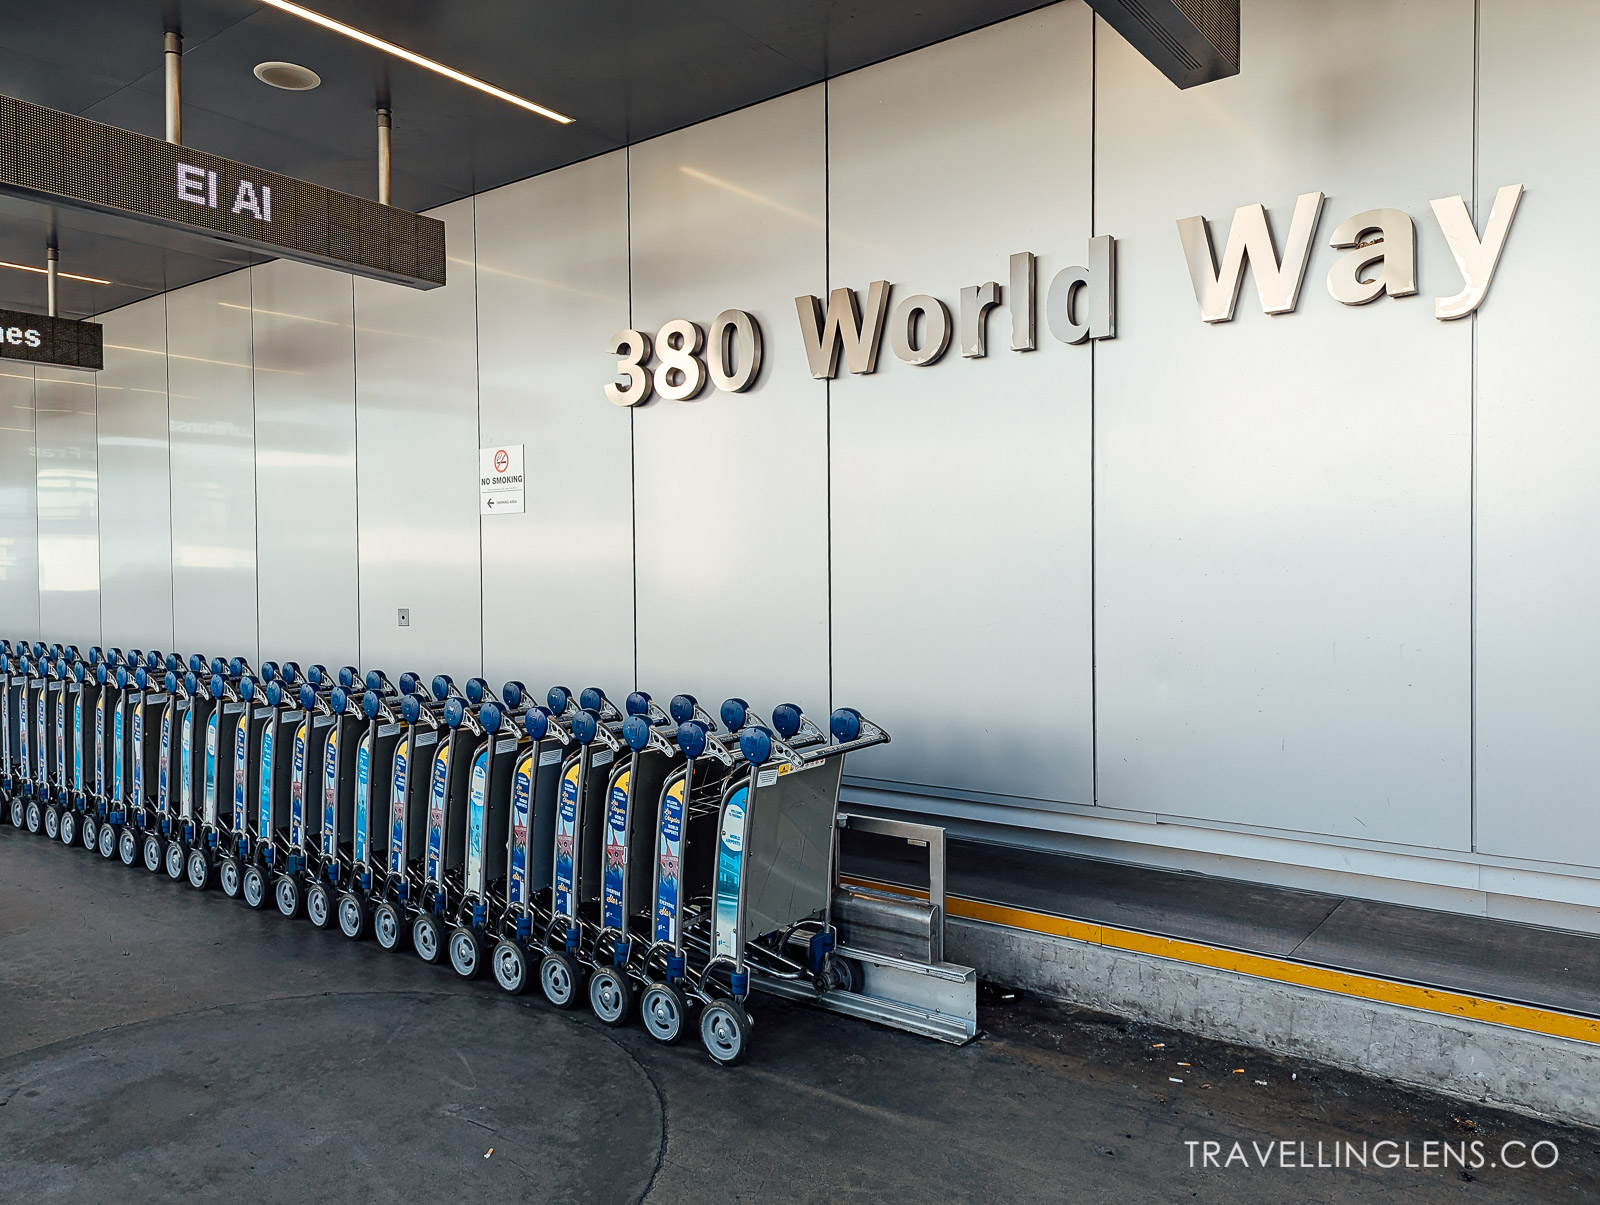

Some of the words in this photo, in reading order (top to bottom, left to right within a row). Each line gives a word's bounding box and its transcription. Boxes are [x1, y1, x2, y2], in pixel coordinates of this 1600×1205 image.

[604, 309, 763, 408] 380
[795, 235, 1118, 380] World
[1176, 184, 1525, 324] Way
[481, 477, 490, 486] NO
[492, 475, 523, 485] SMOKING
